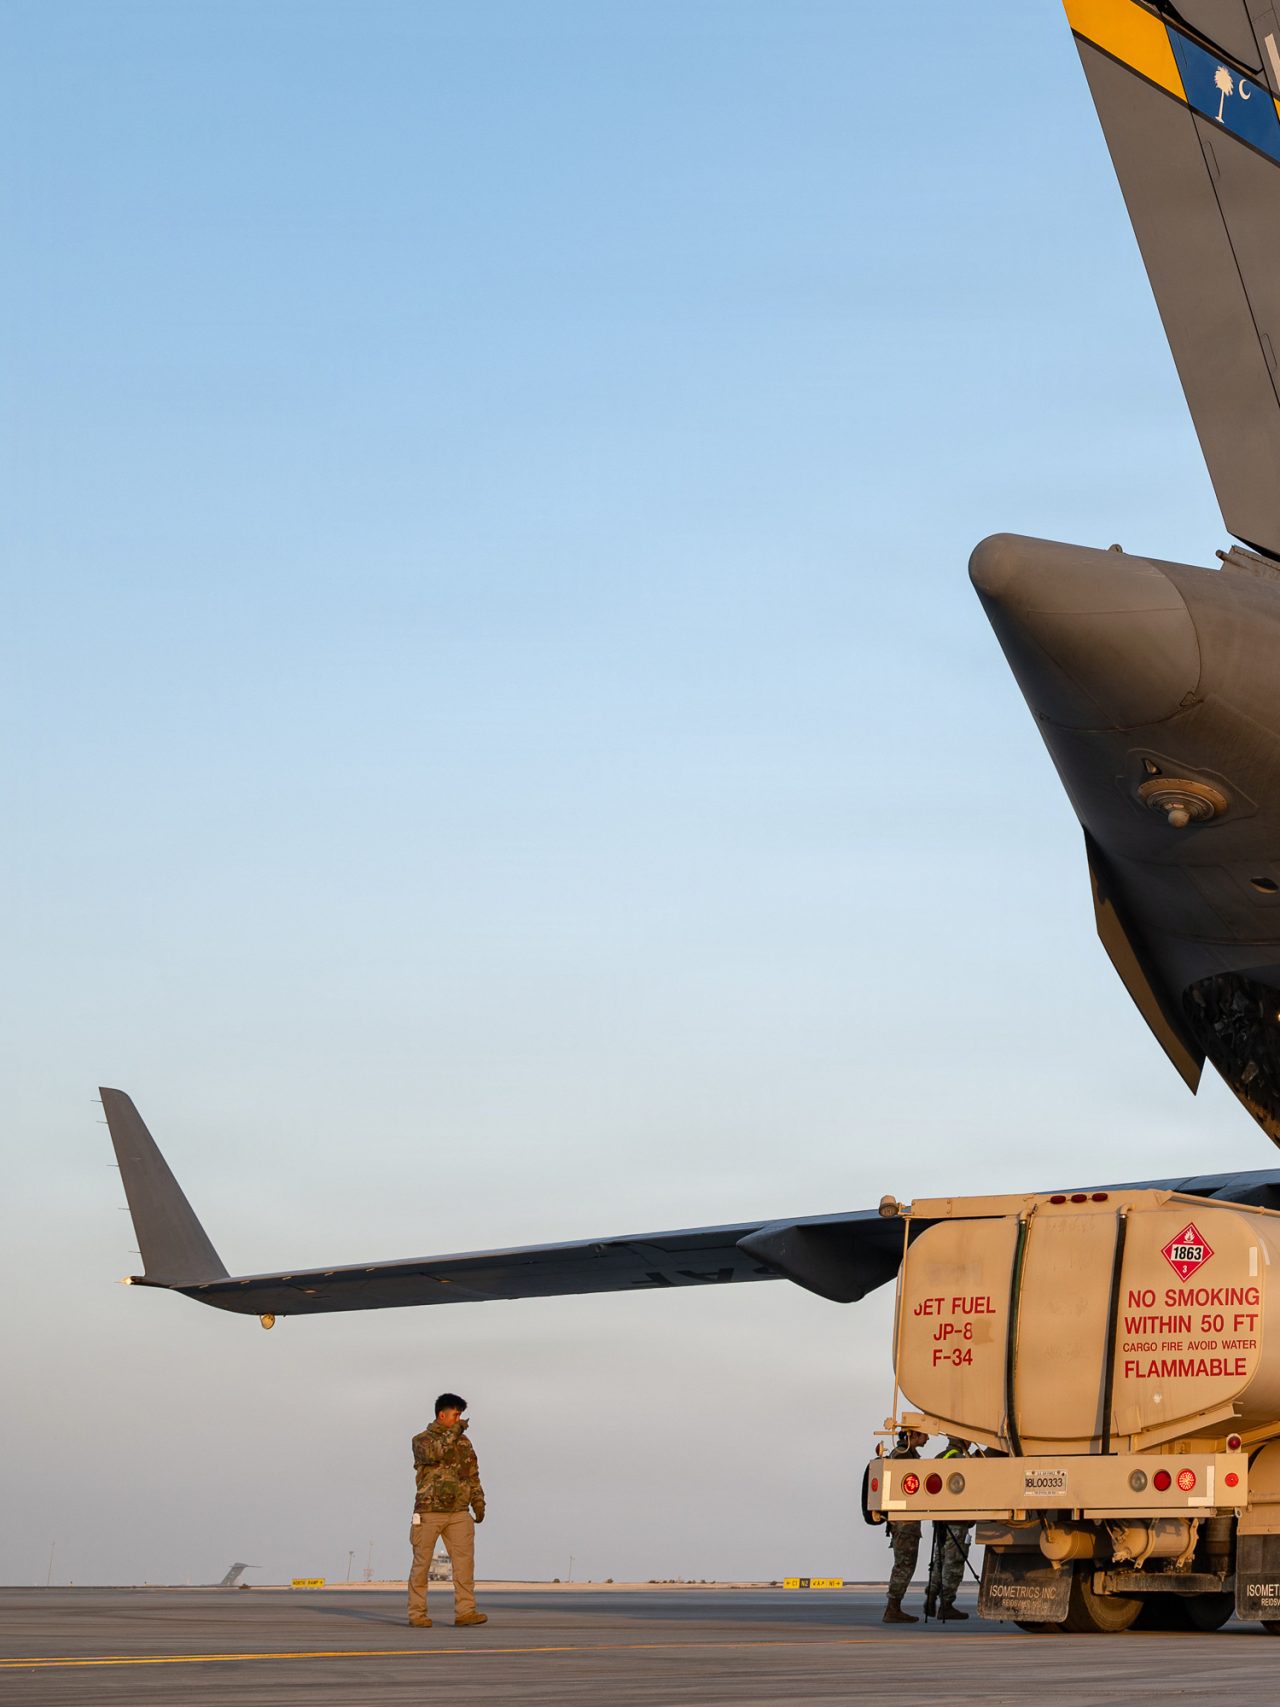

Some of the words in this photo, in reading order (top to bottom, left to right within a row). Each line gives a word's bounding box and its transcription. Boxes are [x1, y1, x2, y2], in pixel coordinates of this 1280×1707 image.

[1173, 1246, 1202, 1260] 1863
[1182, 1265, 1188, 1273] 3
[914, 1297, 945, 1316] JET
[952, 1296, 996, 1314] FUEL
[1128, 1289, 1156, 1308] NO
[1164, 1287, 1260, 1307] SMOKING
[933, 1322, 973, 1341] JP-8
[1124, 1315, 1192, 1334] WITHIN
[1201, 1314, 1225, 1333] 50
[1233, 1313, 1259, 1332] FT
[1123, 1342, 1158, 1352] CARGO
[1161, 1342, 1183, 1351] FIRE
[1187, 1340, 1218, 1350] AVOID
[1222, 1339, 1257, 1350] WATER
[932, 1348, 973, 1367] F-34
[1125, 1358, 1247, 1378] FLAMMABLE
[990, 1585, 1040, 1598] ISOMETRICS
